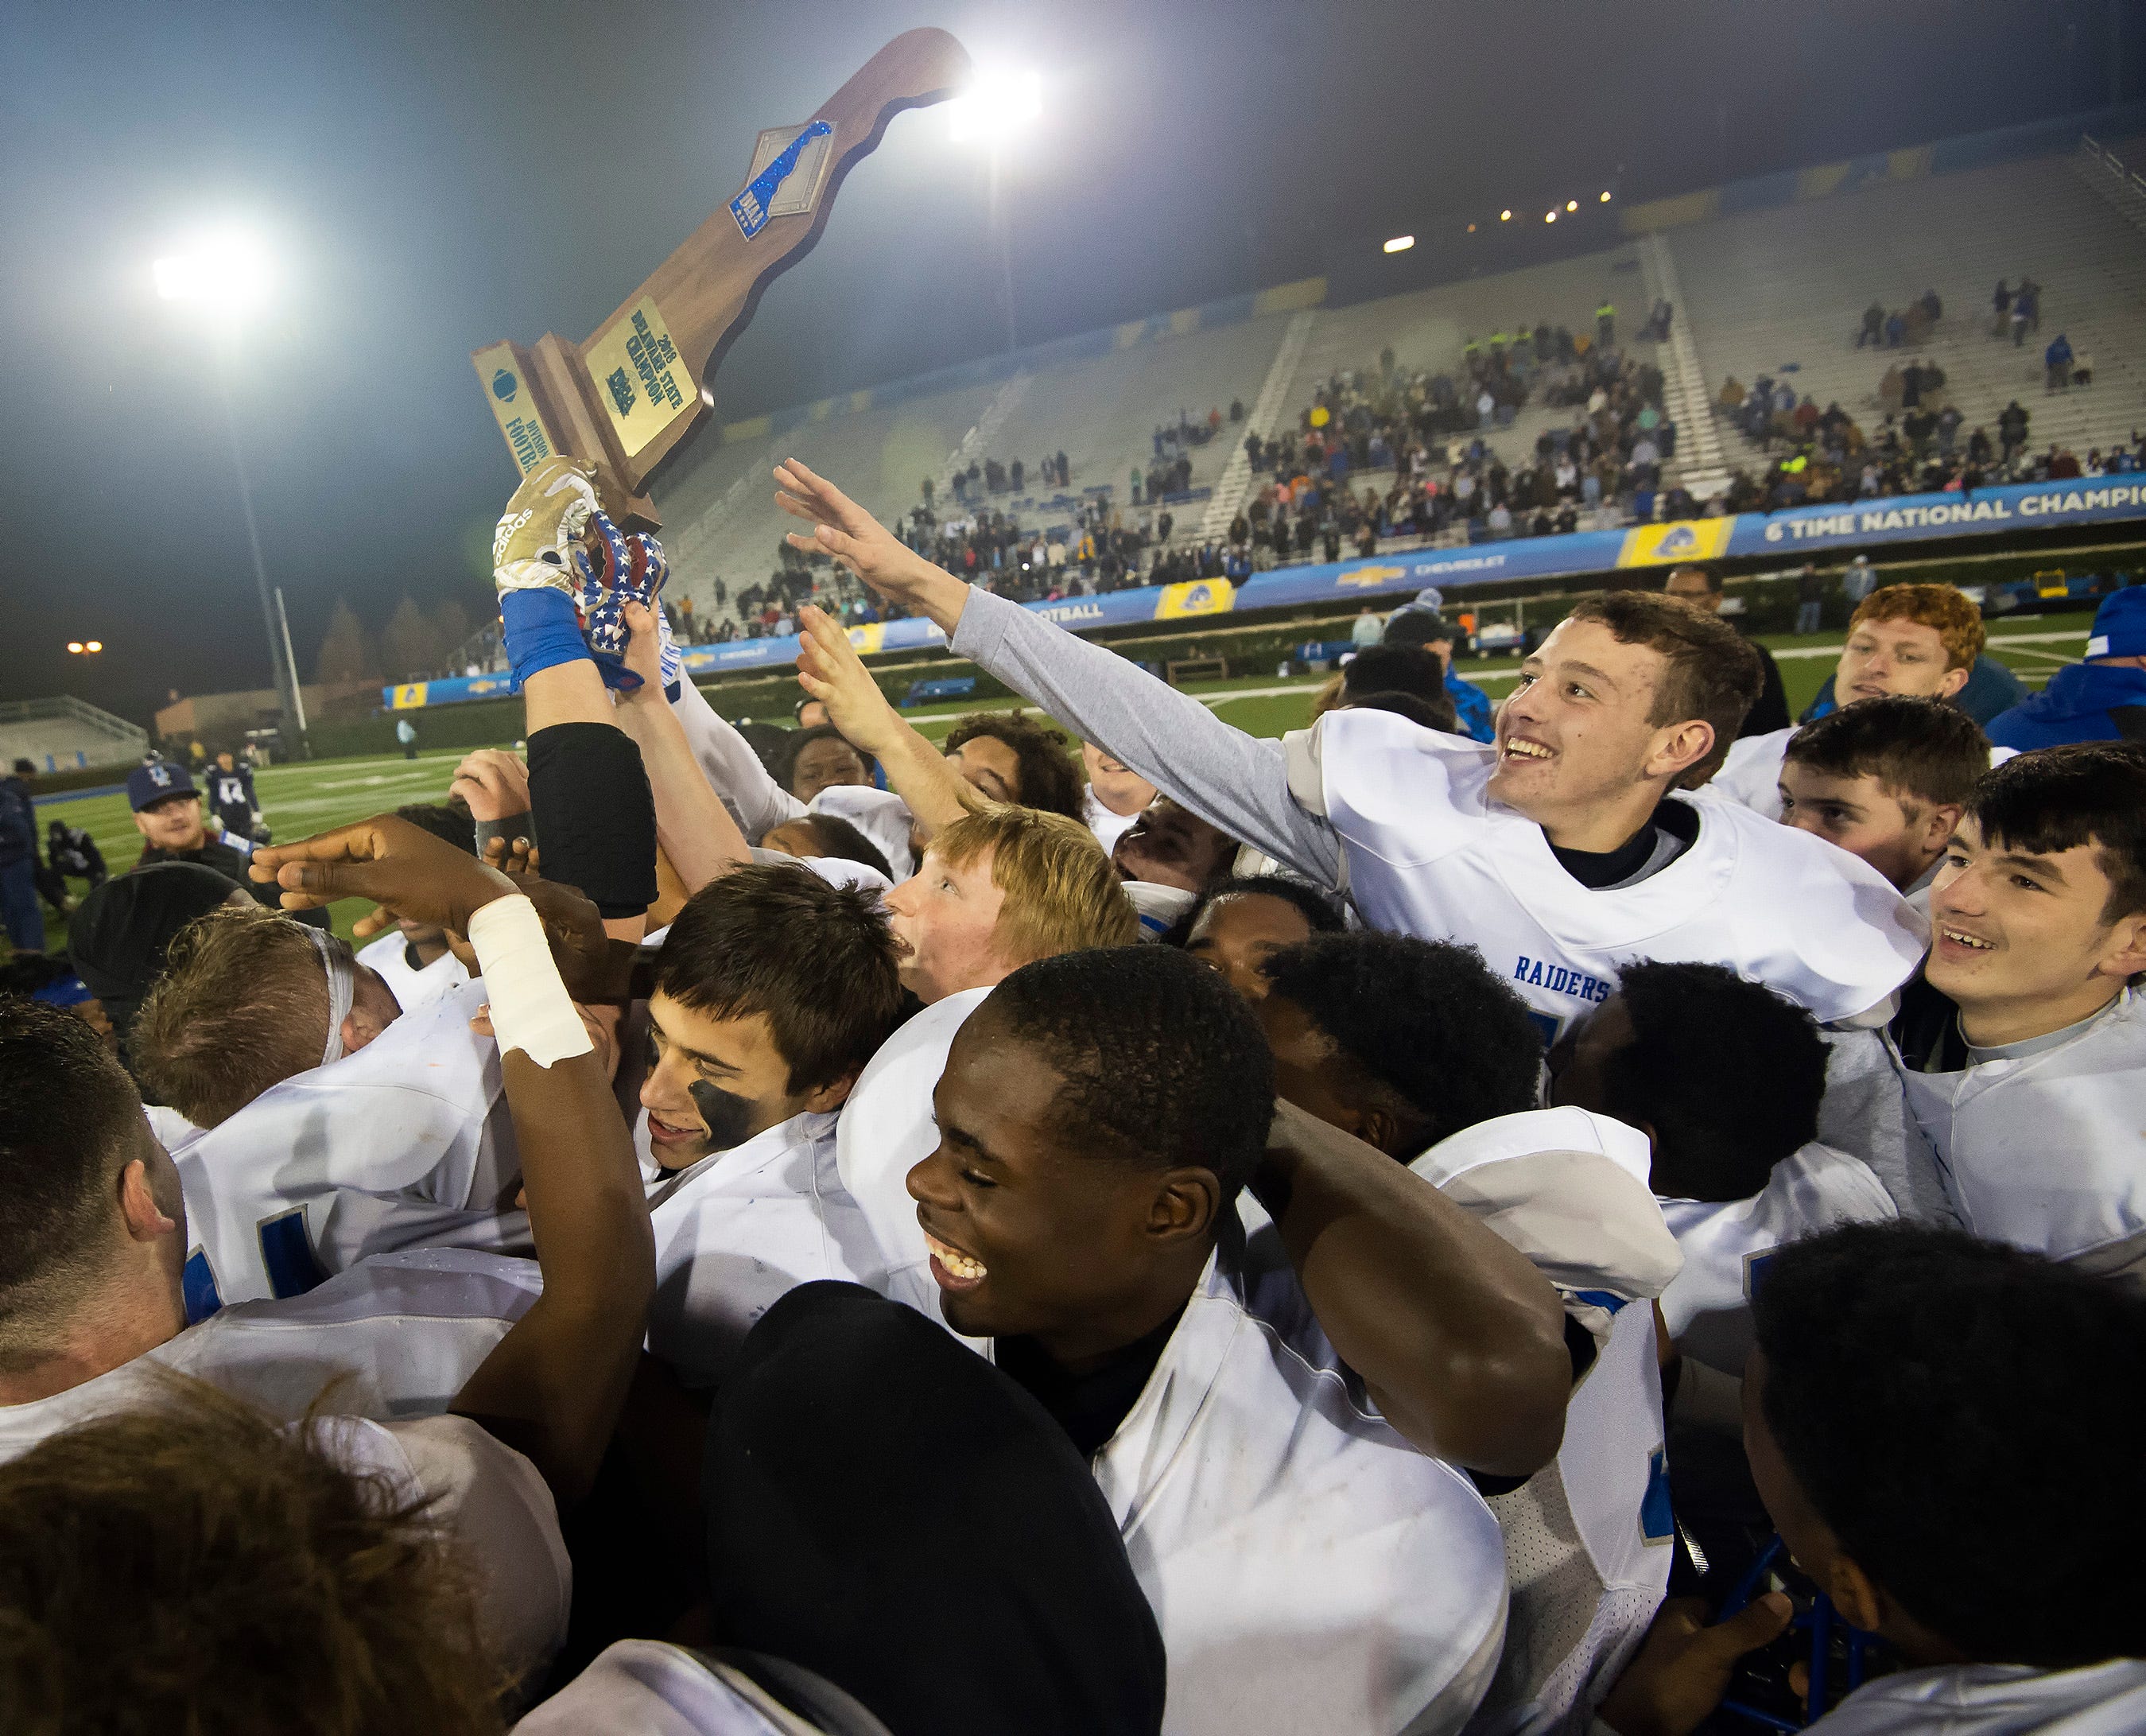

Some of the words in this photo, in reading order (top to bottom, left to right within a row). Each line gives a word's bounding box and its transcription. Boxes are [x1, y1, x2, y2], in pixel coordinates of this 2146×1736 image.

[739, 190, 764, 228] DIAA
[625, 335, 667, 407] CHAMPION
[631, 309, 666, 374] DELAWARE
[660, 371, 683, 410] STATE
[657, 334, 677, 364] 2018
[526, 420, 550, 459] DIVISION
[492, 507, 533, 565] adidas
[1764, 522, 1783, 542] 6
[1789, 515, 1855, 539] TIME
[1861, 499, 2012, 532] NATIONAL
[2019, 485, 2146, 516] CHAMPI
[1513, 955, 1611, 1003] RAIDERS
